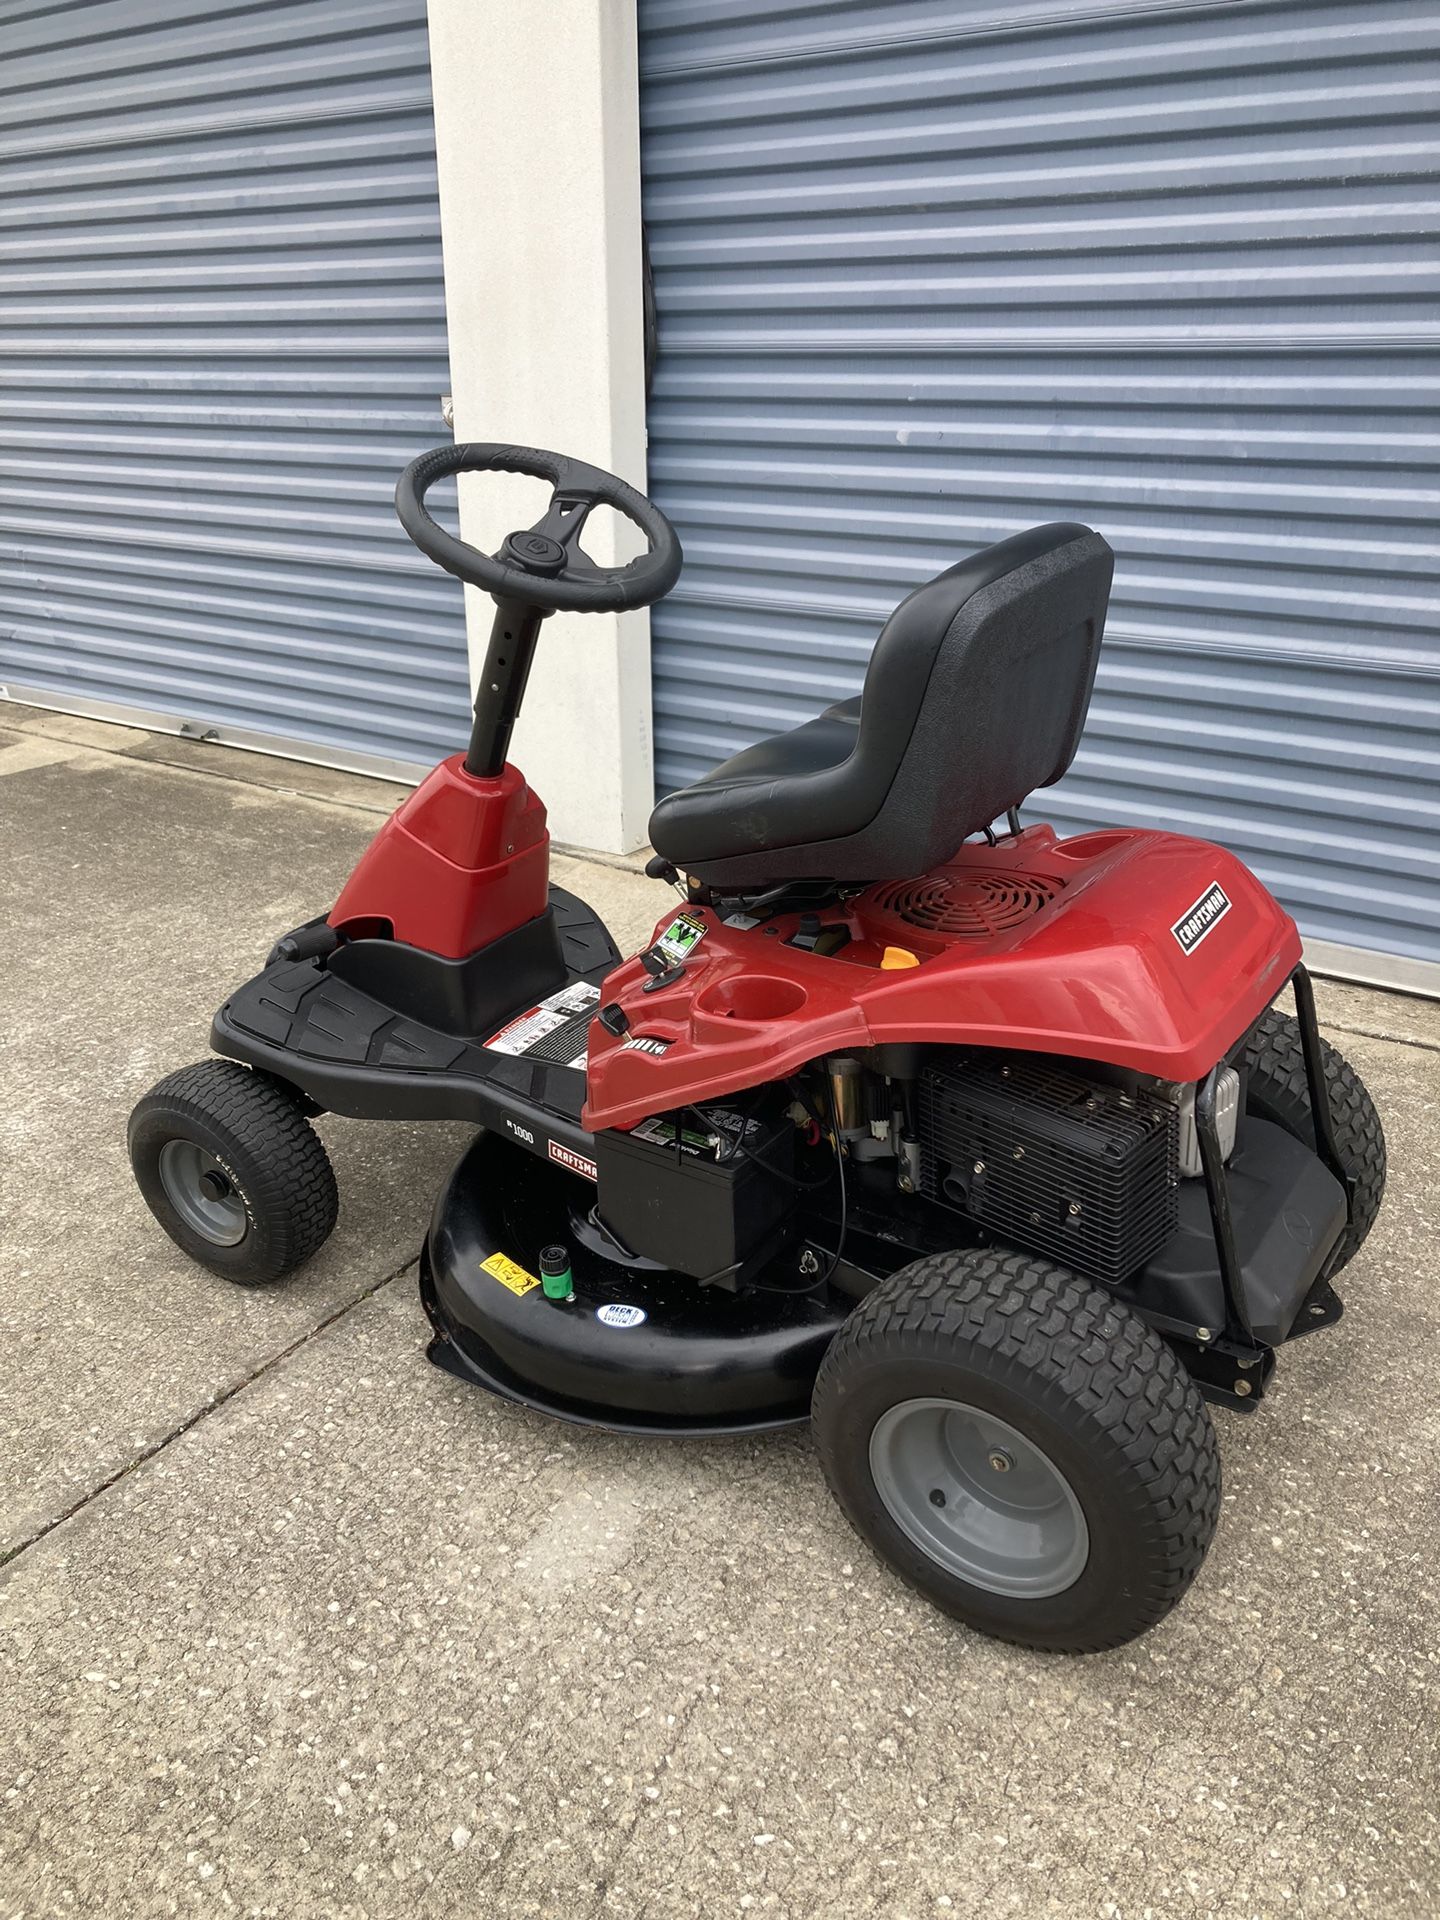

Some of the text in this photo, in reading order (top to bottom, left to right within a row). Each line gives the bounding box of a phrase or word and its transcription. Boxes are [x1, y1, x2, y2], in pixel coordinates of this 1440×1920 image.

[1178, 889, 1227, 945] CRAFTSMAN
[551, 1146, 598, 1178] CRAFTSMA
[609, 1306, 633, 1314] DECK
